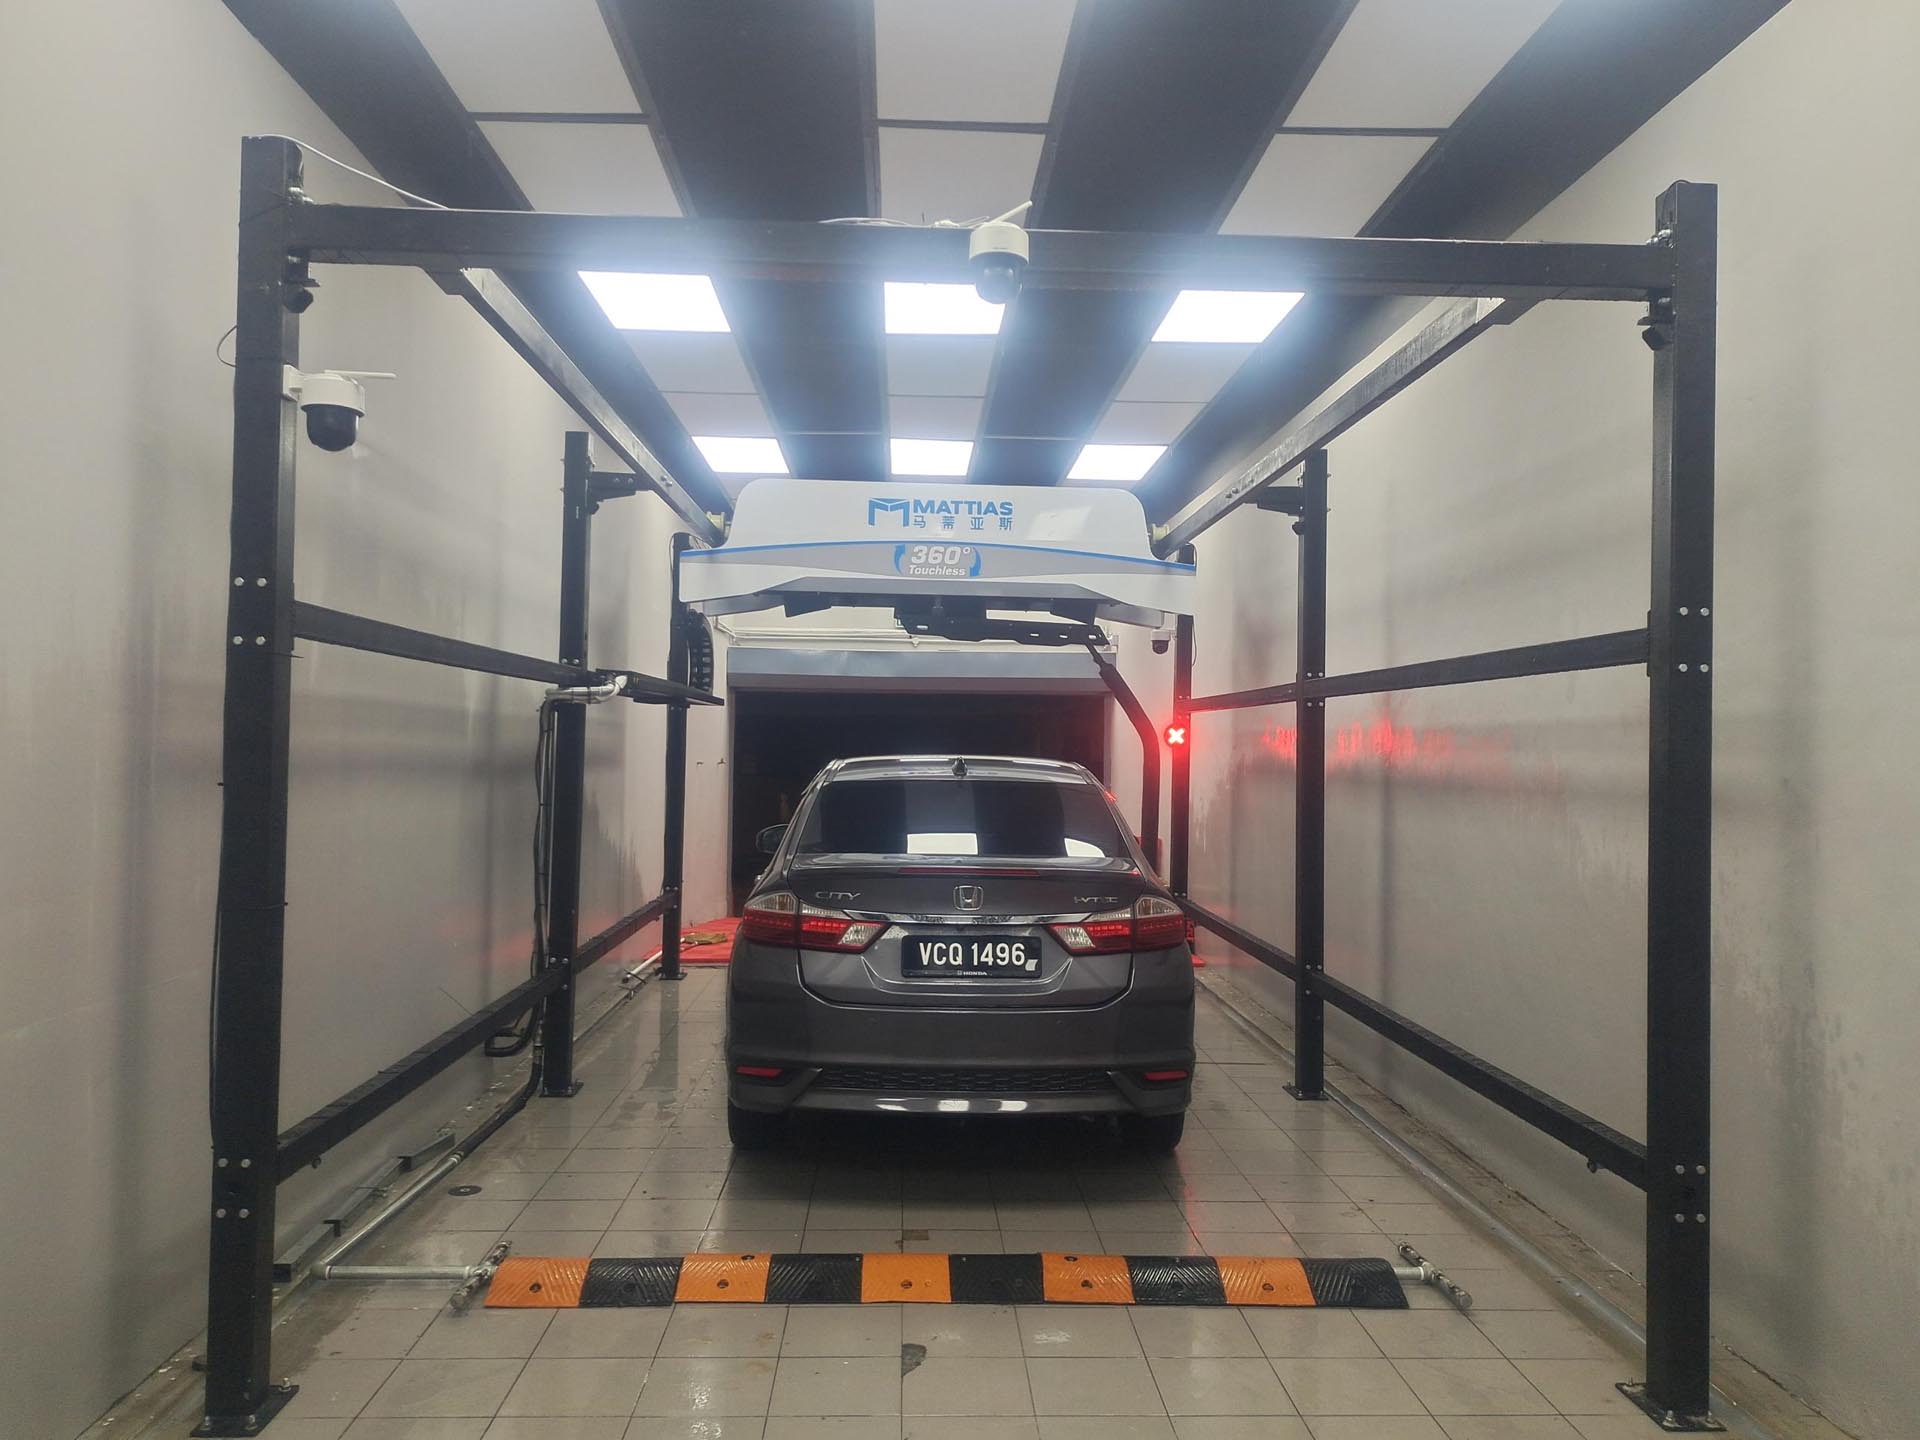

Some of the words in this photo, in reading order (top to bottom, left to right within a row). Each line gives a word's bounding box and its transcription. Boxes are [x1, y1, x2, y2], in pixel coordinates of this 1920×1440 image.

[913, 499, 1013, 516] MATTIAS
[908, 564, 966, 576] Touchless
[919, 942, 963, 966] VCQ
[971, 942, 1026, 966] 1496
